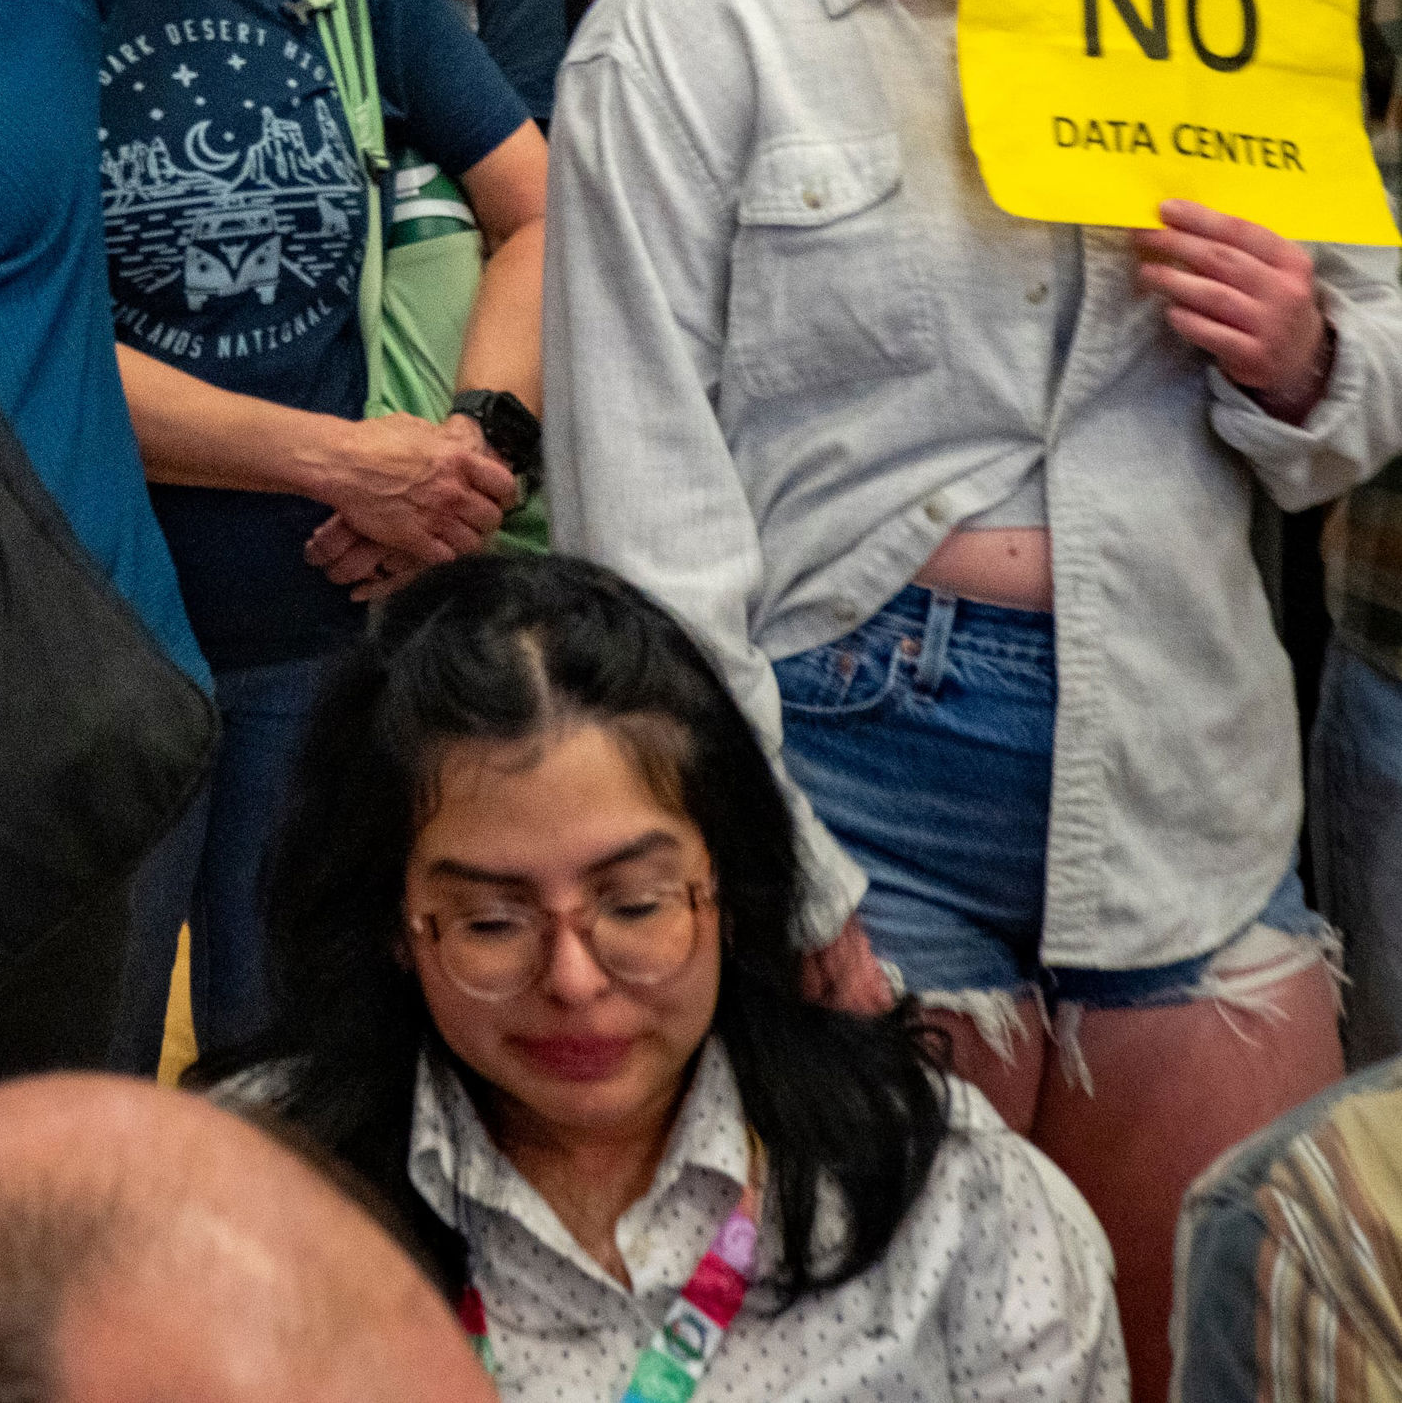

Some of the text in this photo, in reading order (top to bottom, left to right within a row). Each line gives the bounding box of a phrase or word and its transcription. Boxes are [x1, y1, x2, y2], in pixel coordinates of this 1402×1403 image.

[164, 17, 268, 47] DESERT
[1051, 115, 1307, 173] DATA CENTER
[216, 298, 334, 359] NATIONAL
